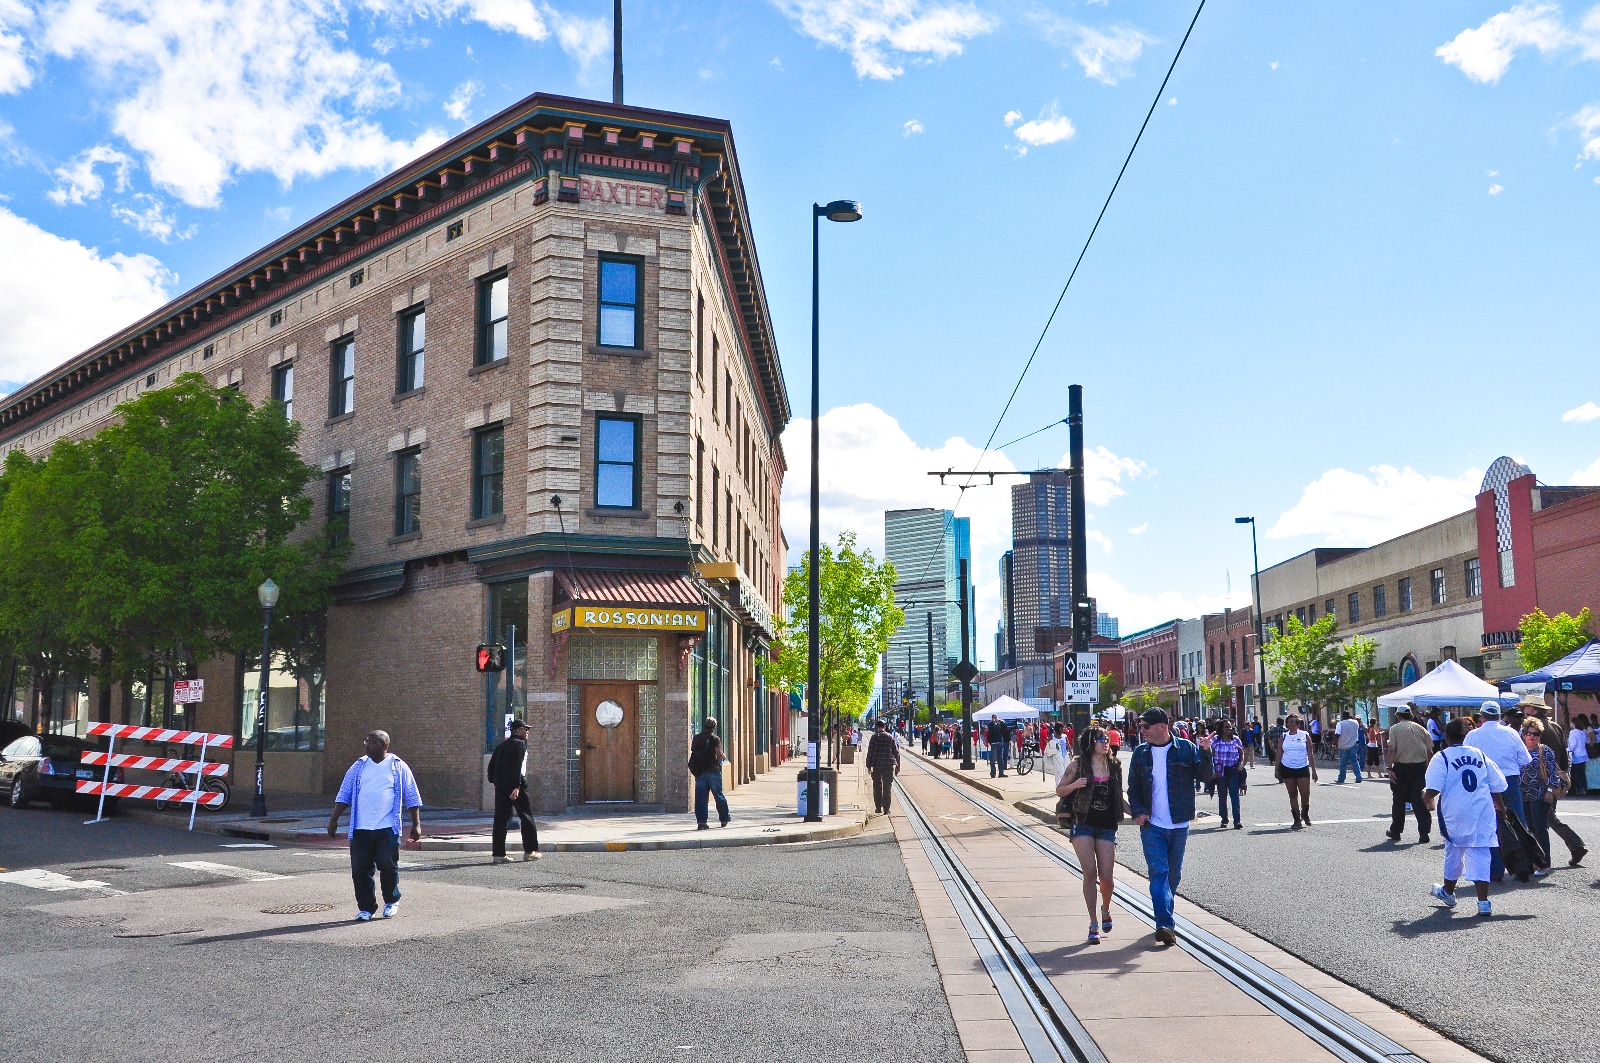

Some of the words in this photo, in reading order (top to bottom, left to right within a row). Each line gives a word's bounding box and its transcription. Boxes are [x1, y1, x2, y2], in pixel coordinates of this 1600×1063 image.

[579, 178, 665, 210] BAXTER
[584, 611, 698, 627] ROSSONIAN
[1078, 662, 1097, 670] TRAIN
[1079, 670, 1095, 678] ONLY
[1451, 755, 1484, 771] ARENAS
[1461, 768, 1478, 793] 0
